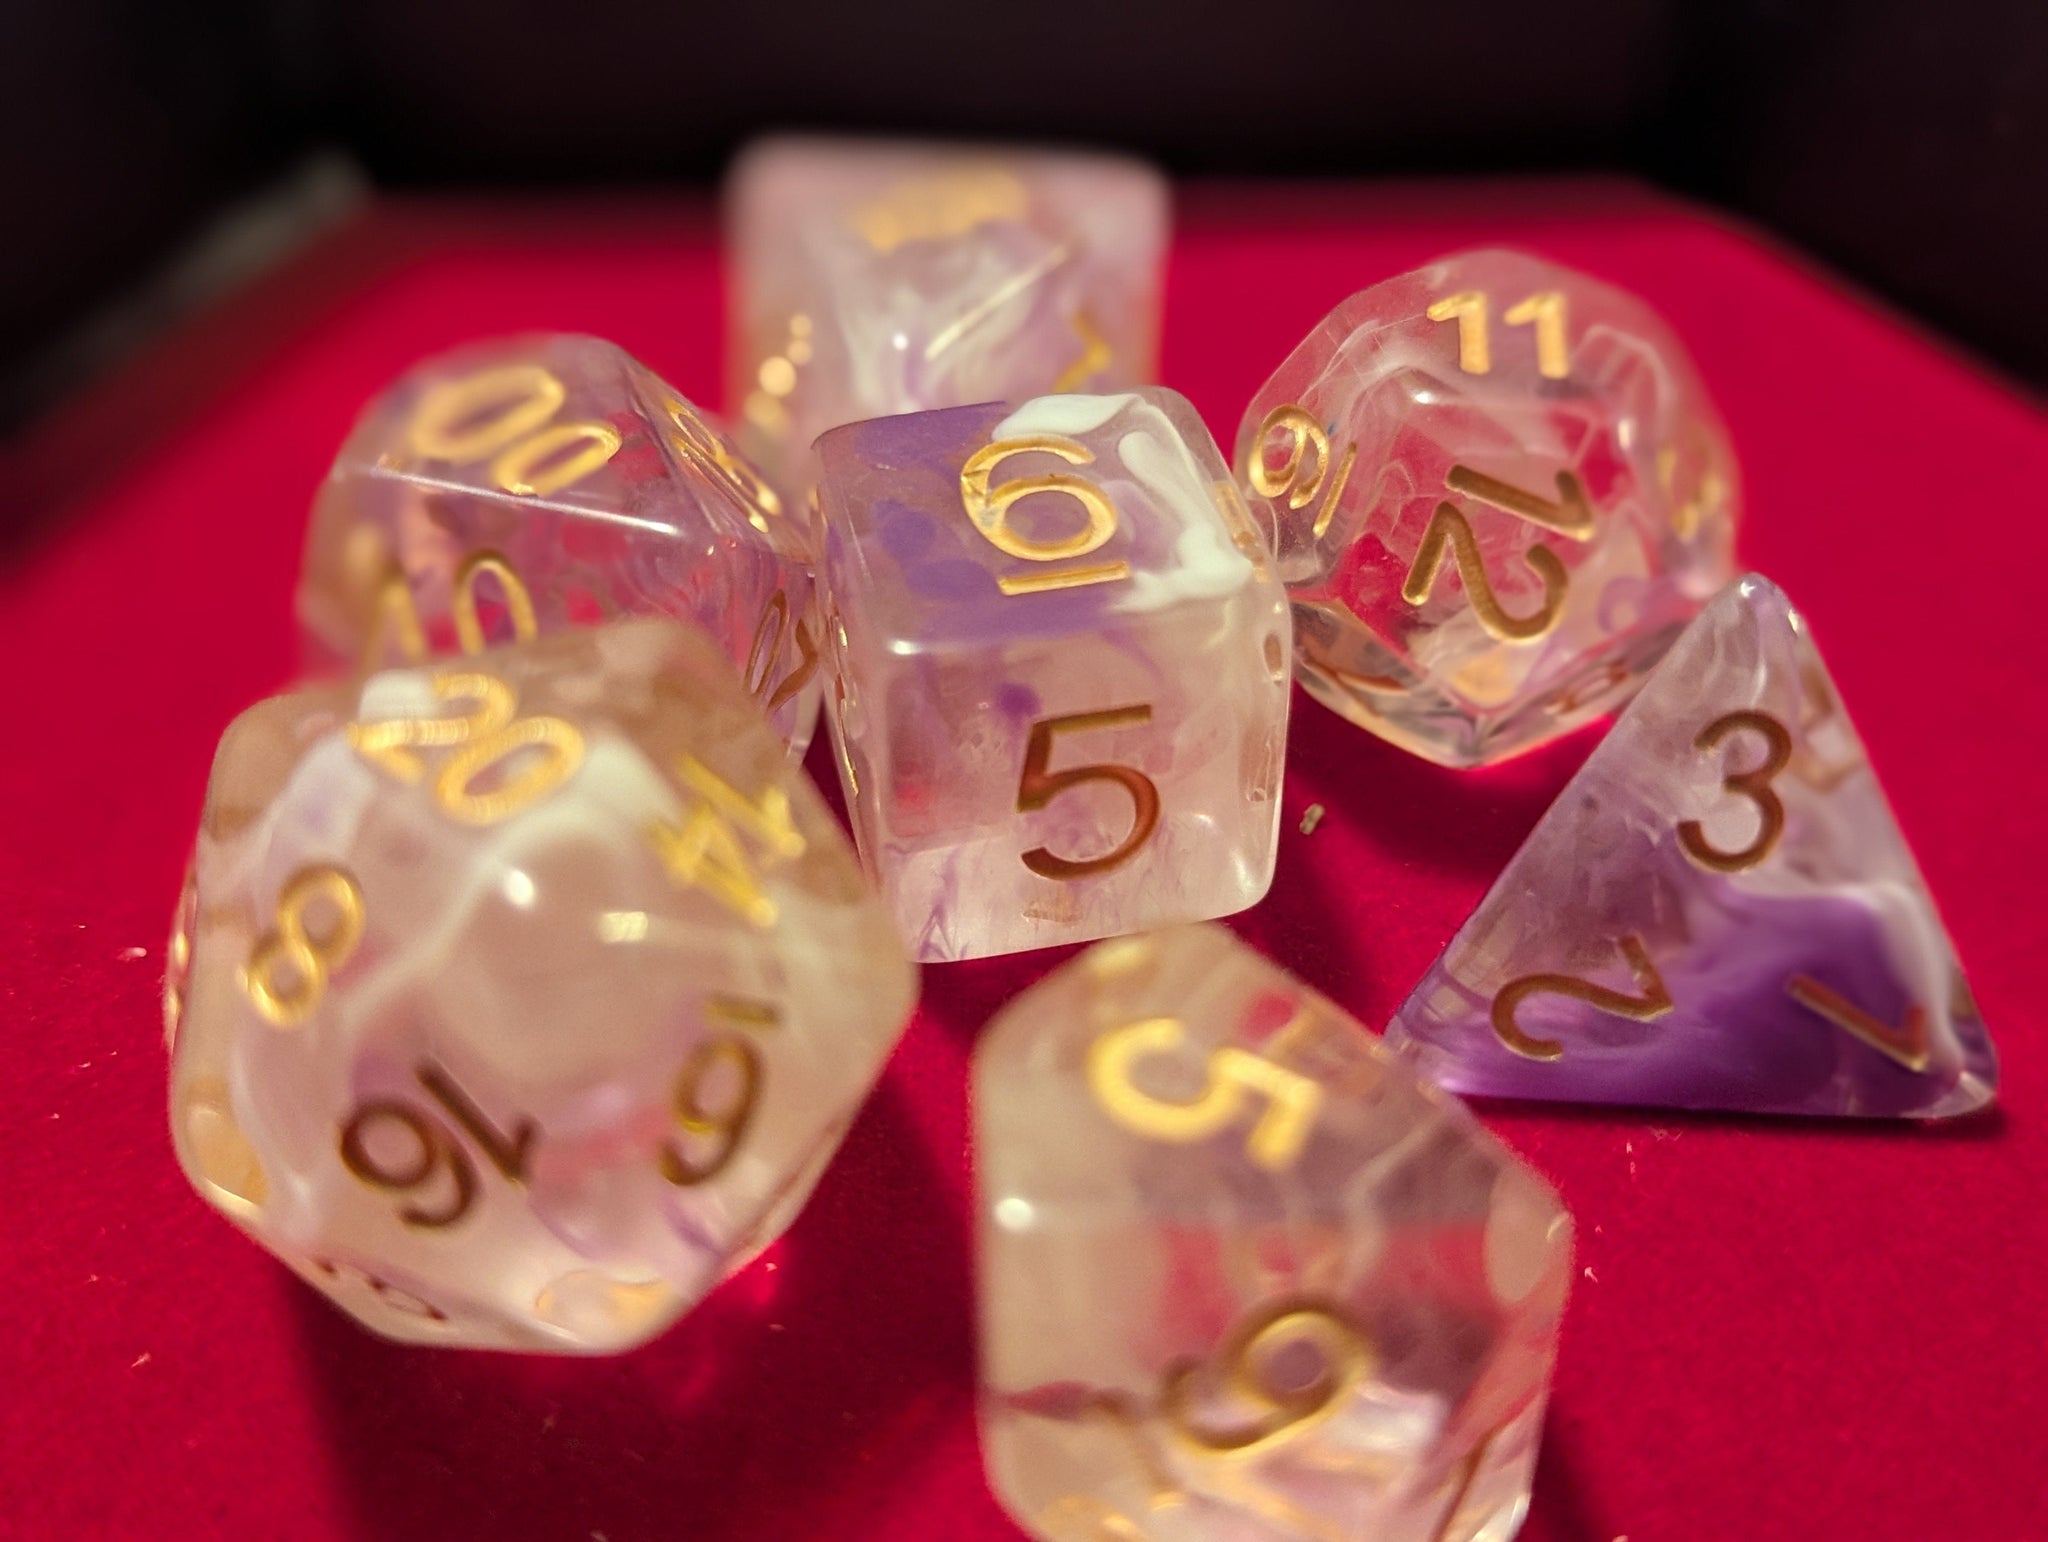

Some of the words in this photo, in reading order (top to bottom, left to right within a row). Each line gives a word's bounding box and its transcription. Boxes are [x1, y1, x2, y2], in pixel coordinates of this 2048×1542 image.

[1427, 291, 1570, 379] 11
[412, 365, 622, 498] 00
[960, 435, 1131, 596] 6
[1402, 464, 1593, 646] 12
[346, 672, 586, 826] 20
[1016, 703, 1161, 881] 5
[1675, 708, 1792, 874] 3
[652, 752, 806, 928] 14
[245, 860, 366, 1028] 8
[1491, 931, 1675, 1061] 2
[338, 1058, 540, 1230] 16
[1087, 1018, 1322, 1172] 5
